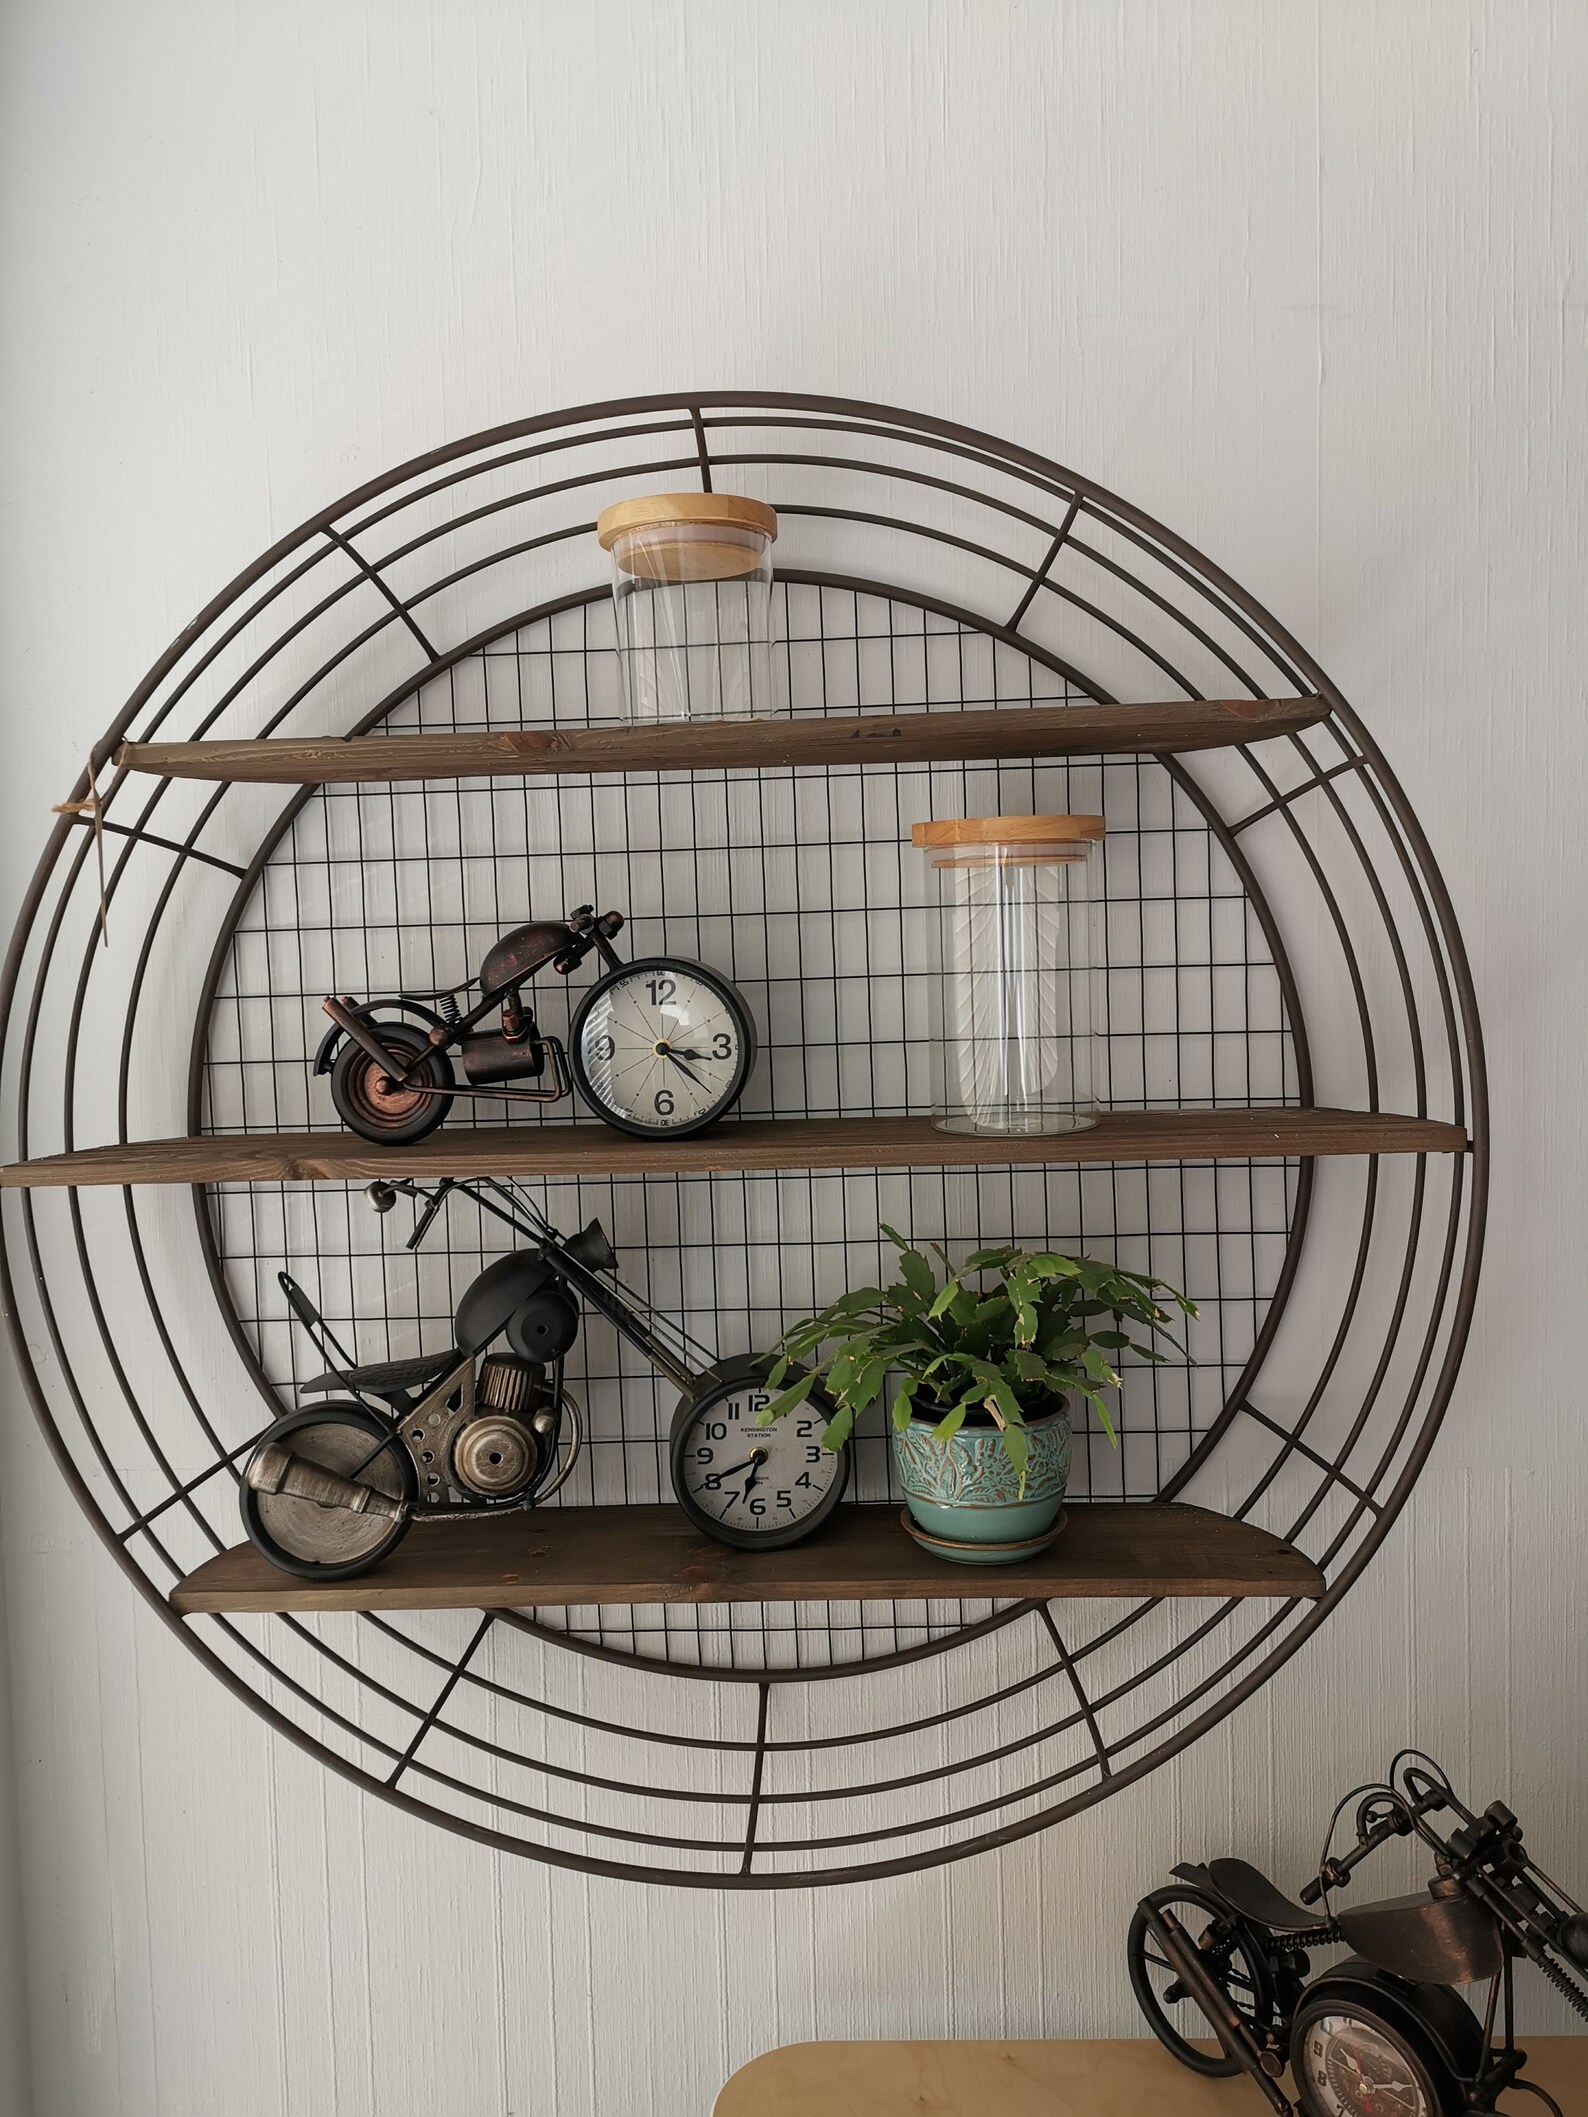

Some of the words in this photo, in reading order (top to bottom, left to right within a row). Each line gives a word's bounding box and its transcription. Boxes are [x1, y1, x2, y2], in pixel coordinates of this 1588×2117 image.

[645, 979, 677, 1006] 12
[712, 1033, 732, 1060] 3
[654, 1089, 675, 1116] 6
[728, 1402, 740, 1420] 11
[748, 1394, 770, 1412] 12
[705, 1422, 727, 1441] 10
[796, 1420, 812, 1438] 2
[697, 1447, 714, 1465] 9
[805, 1446, 821, 1463] 3
[705, 1473, 722, 1490] 8
[795, 1471, 812, 1489] 4
[724, 1491, 741, 1509] 7
[749, 1498, 767, 1516] 6
[776, 1490, 791, 1508] 5
[1313, 2040, 1324, 2058] 9
[1317, 2070, 1327, 2087] 8
